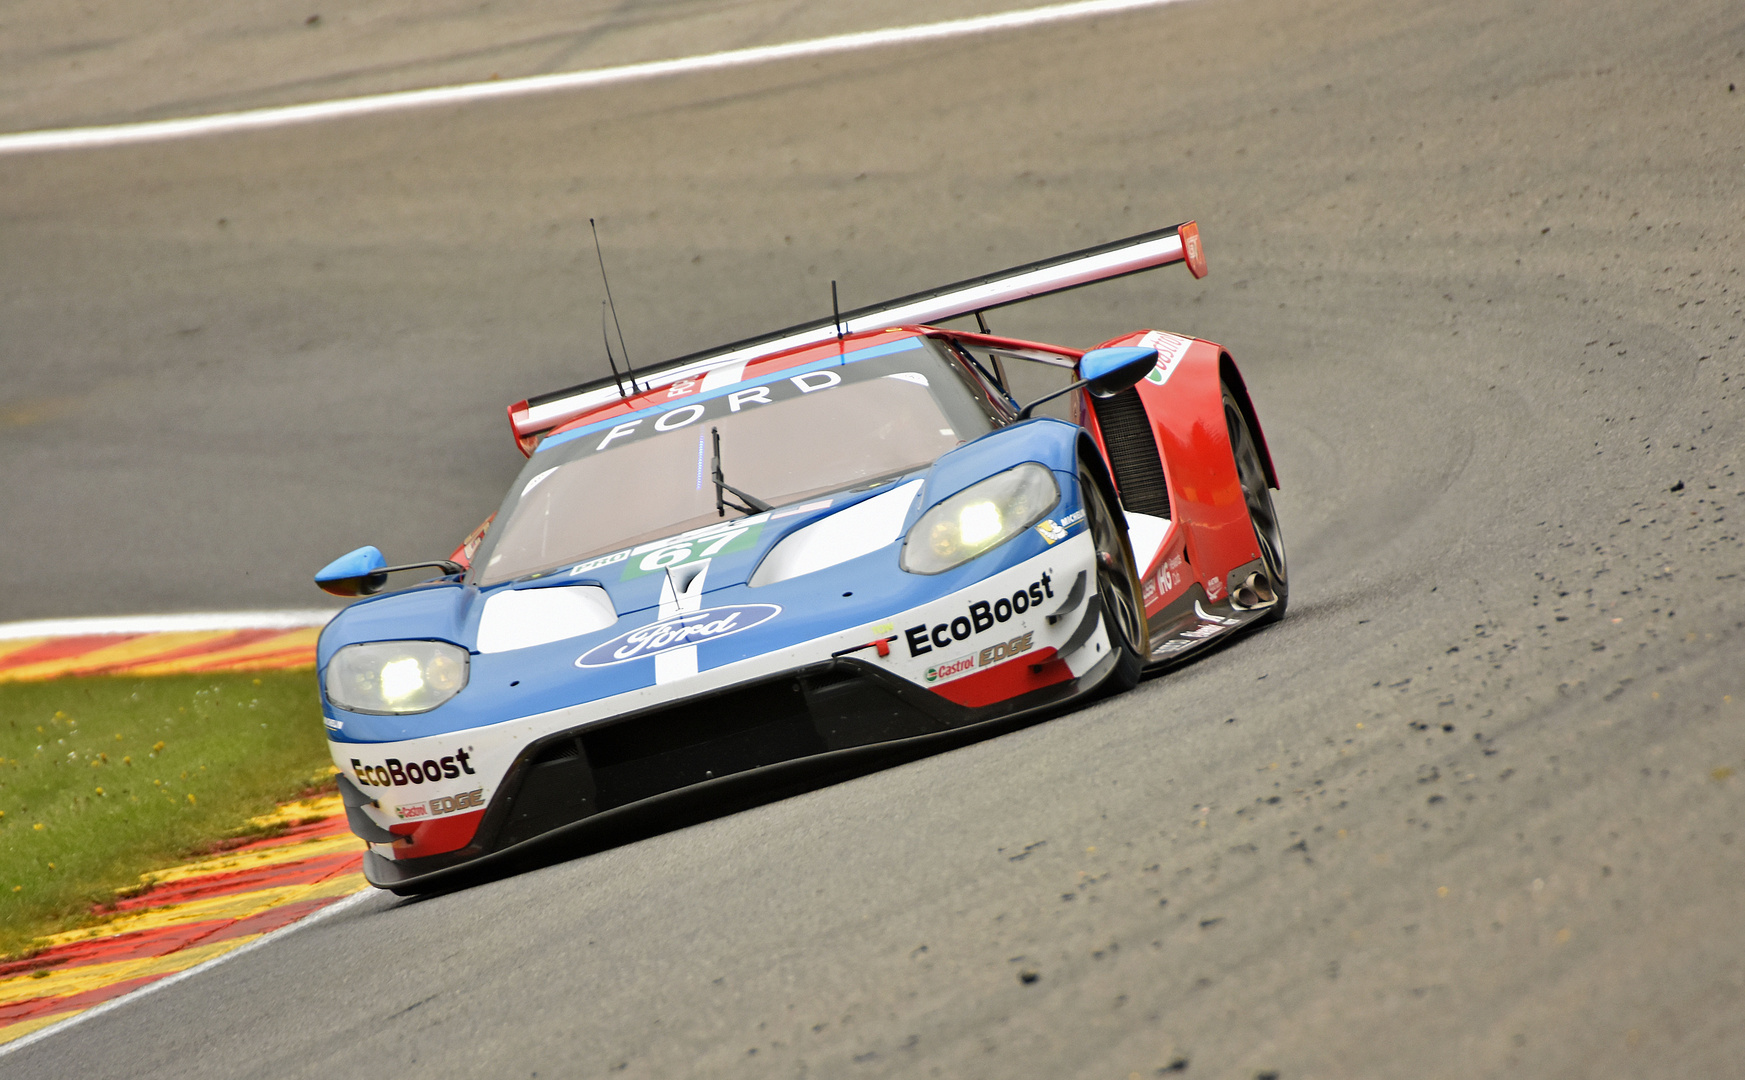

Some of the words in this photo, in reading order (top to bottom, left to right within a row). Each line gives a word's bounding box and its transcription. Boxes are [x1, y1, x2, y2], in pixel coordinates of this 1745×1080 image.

[596, 370, 842, 451] FORD
[575, 552, 626, 573] PRO
[639, 526, 750, 571] 67
[613, 611, 742, 659] Ford
[905, 571, 1054, 658] EcoBoost
[938, 655, 974, 678] Castrol
[978, 630, 1035, 667] EDGE
[350, 747, 476, 787] EcoBoost
[402, 804, 428, 818] Castrol
[429, 788, 486, 816] EDGE
